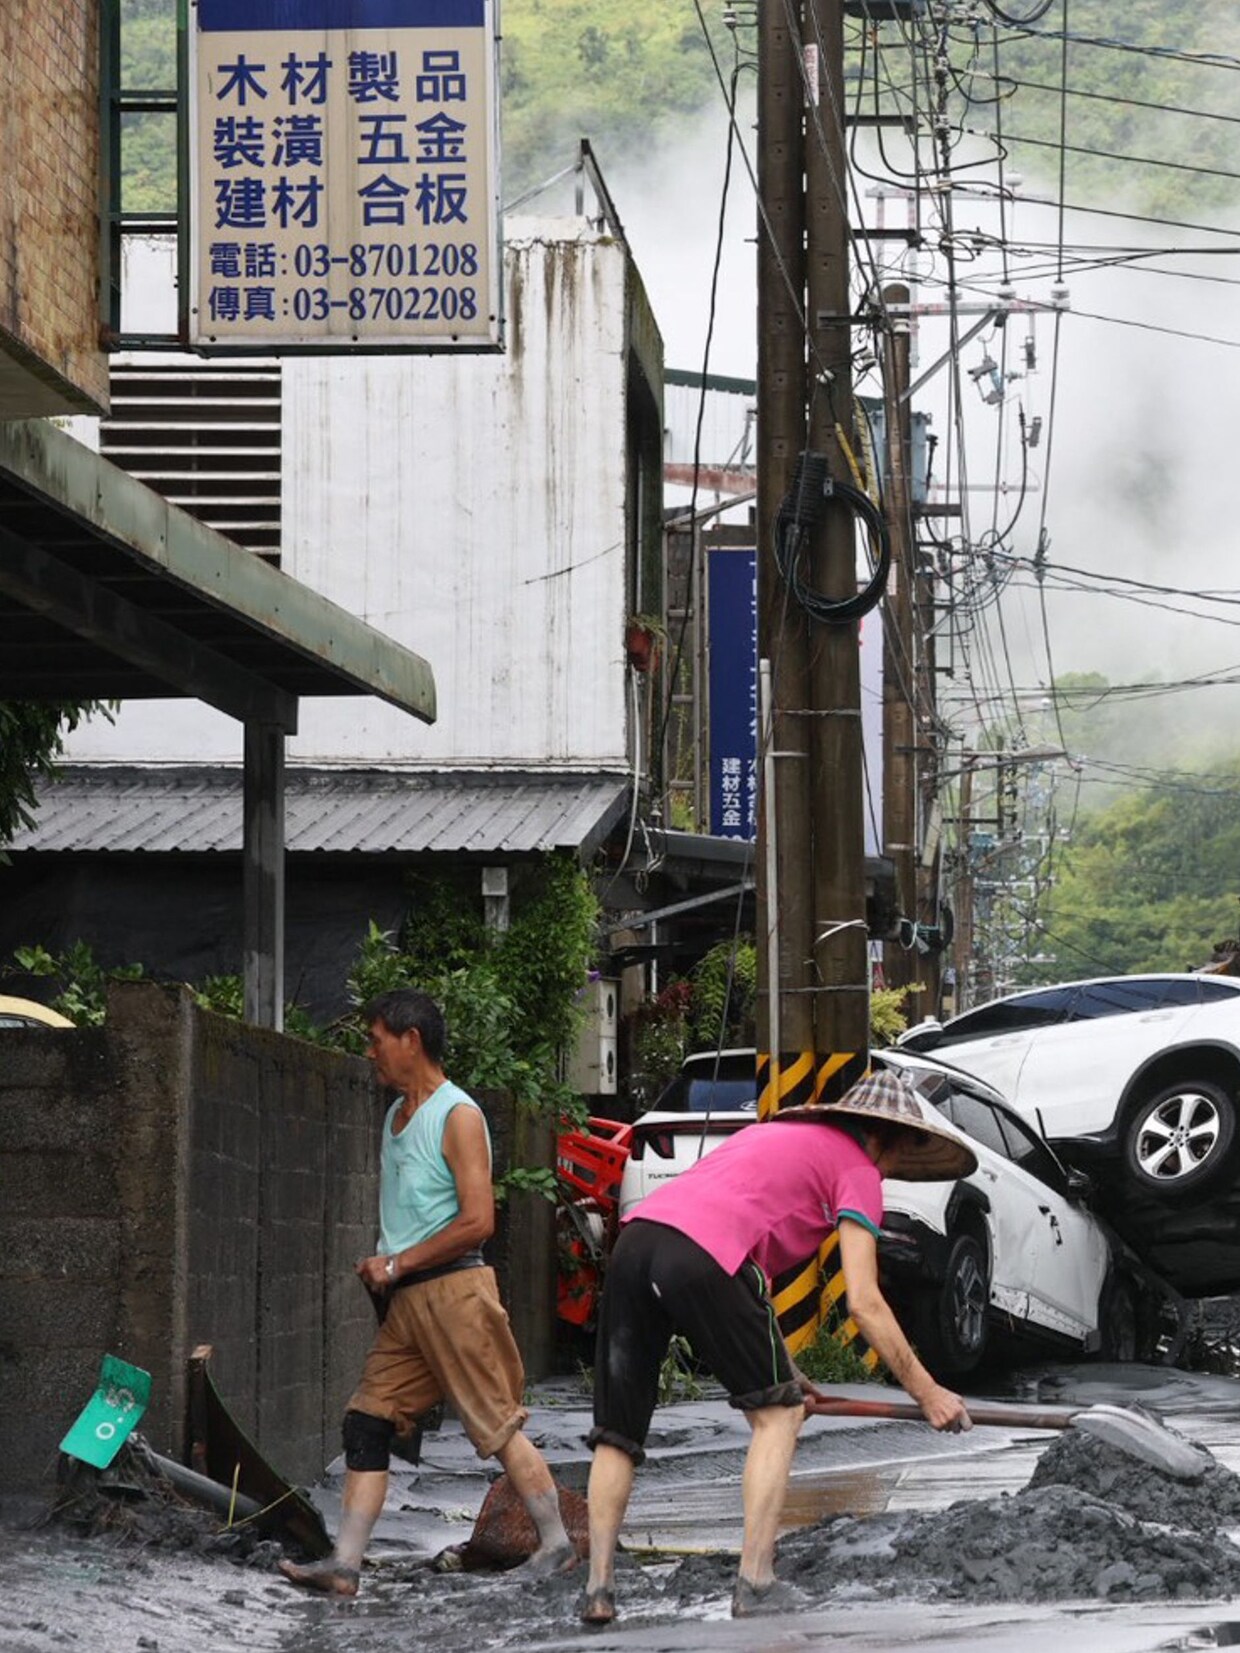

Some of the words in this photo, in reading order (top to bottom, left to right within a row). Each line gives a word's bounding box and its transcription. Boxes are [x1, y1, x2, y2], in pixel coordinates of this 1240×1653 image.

[216, 50, 467, 106] 木材製品
[213, 115, 324, 169] 裝潢
[356, 111, 467, 165] 五金
[213, 175, 325, 230] 建材
[356, 173, 469, 226] 合板
[721, 757, 742, 827] 建材五金
